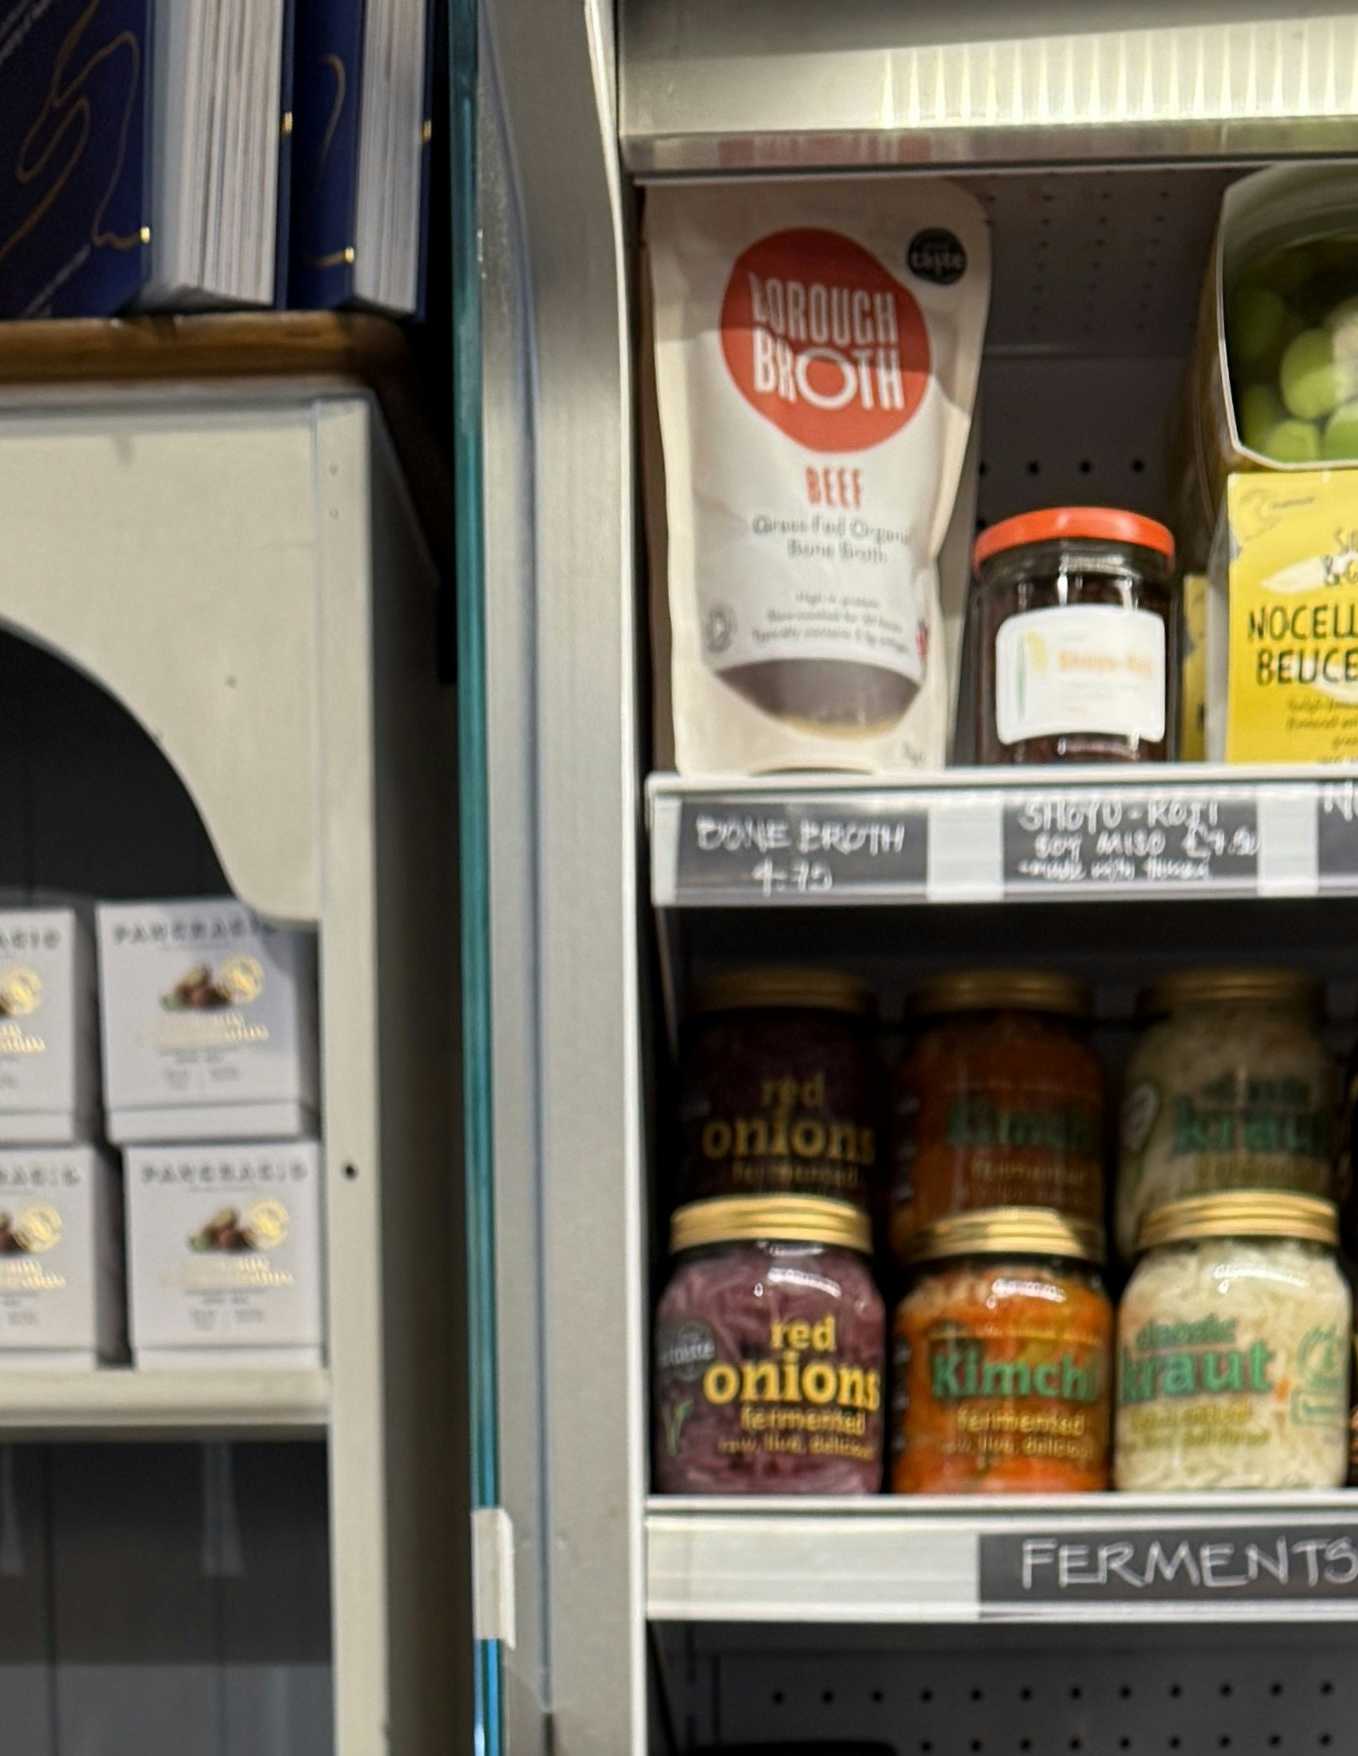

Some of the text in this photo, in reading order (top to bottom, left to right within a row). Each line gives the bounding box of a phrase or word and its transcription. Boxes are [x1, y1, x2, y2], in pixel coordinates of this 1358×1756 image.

[749, 270, 898, 350] BOROUGH
[752, 330, 905, 411] BROTH
[804, 466, 863, 511] BEEF
[770, 1314, 838, 1354] red
[702, 1352, 881, 1412] onions
[1119, 1341, 1276, 1403] kraut
